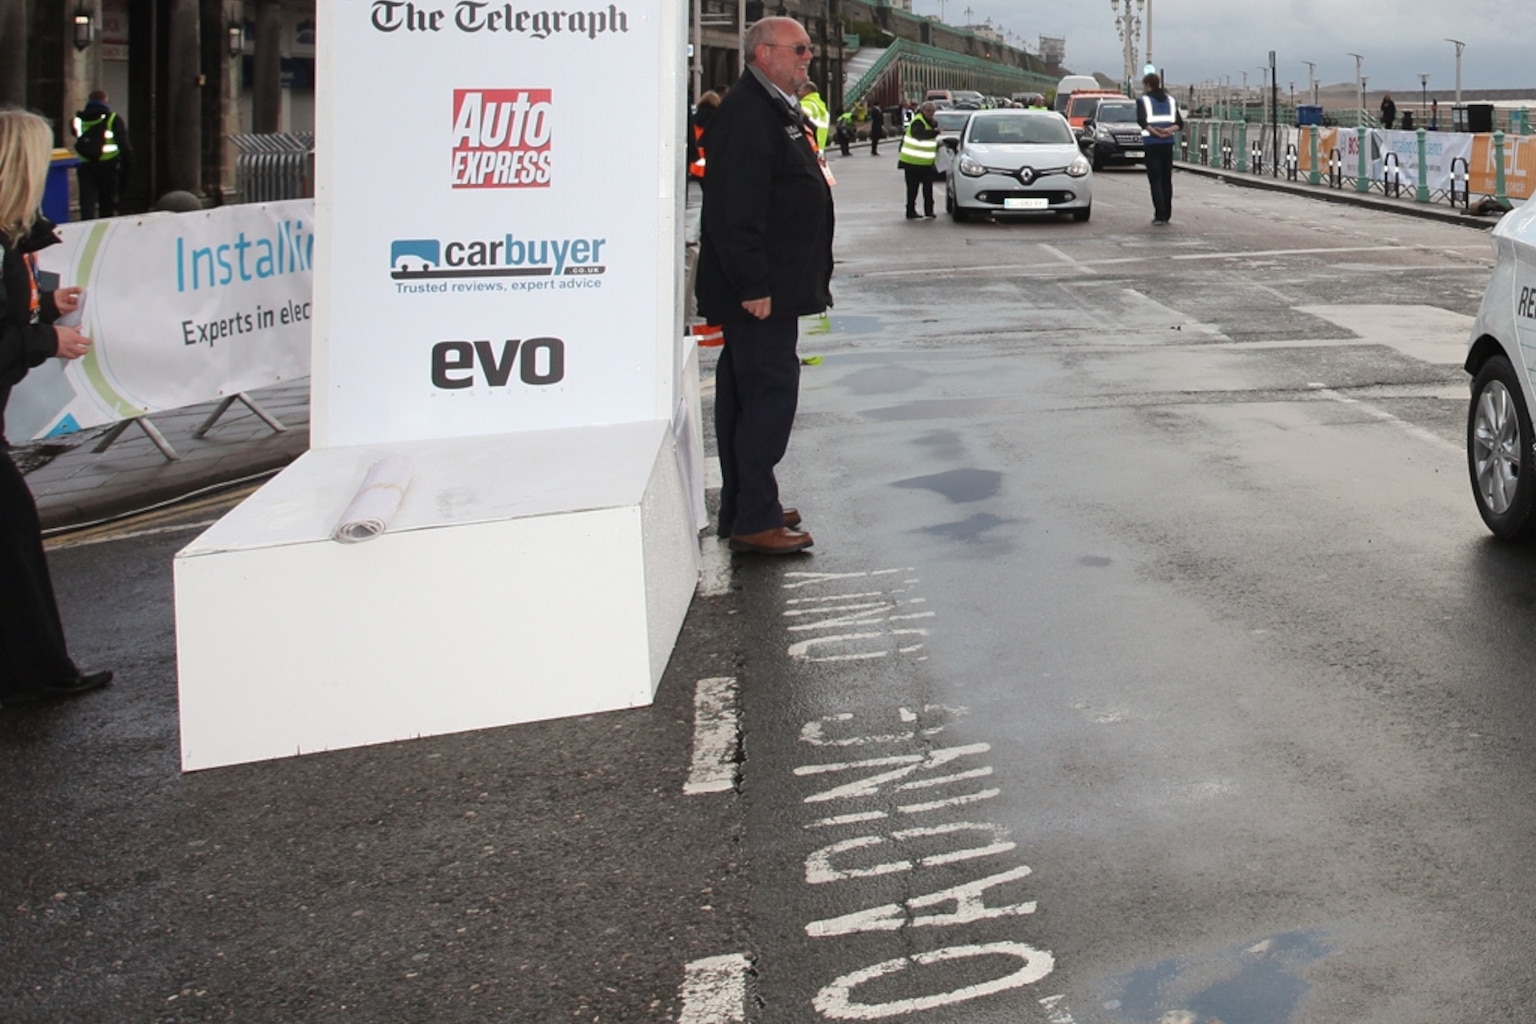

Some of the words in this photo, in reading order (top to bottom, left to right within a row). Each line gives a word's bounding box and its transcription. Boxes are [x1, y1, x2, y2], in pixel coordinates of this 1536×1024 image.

[371, 0, 445, 33] The
[454, 0, 629, 40] Telegraph
[452, 92, 552, 148] Auto
[452, 150, 551, 185] EXPRESS
[445, 233, 607, 276] carbuyer
[396, 282, 447, 294] Trusted
[452, 281, 507, 293] reviews,
[511, 279, 555, 292] expert
[558, 278, 602, 290] advice
[182, 312, 252, 347] Experts
[257, 306, 274, 329] in
[431, 337, 565, 390] evo
